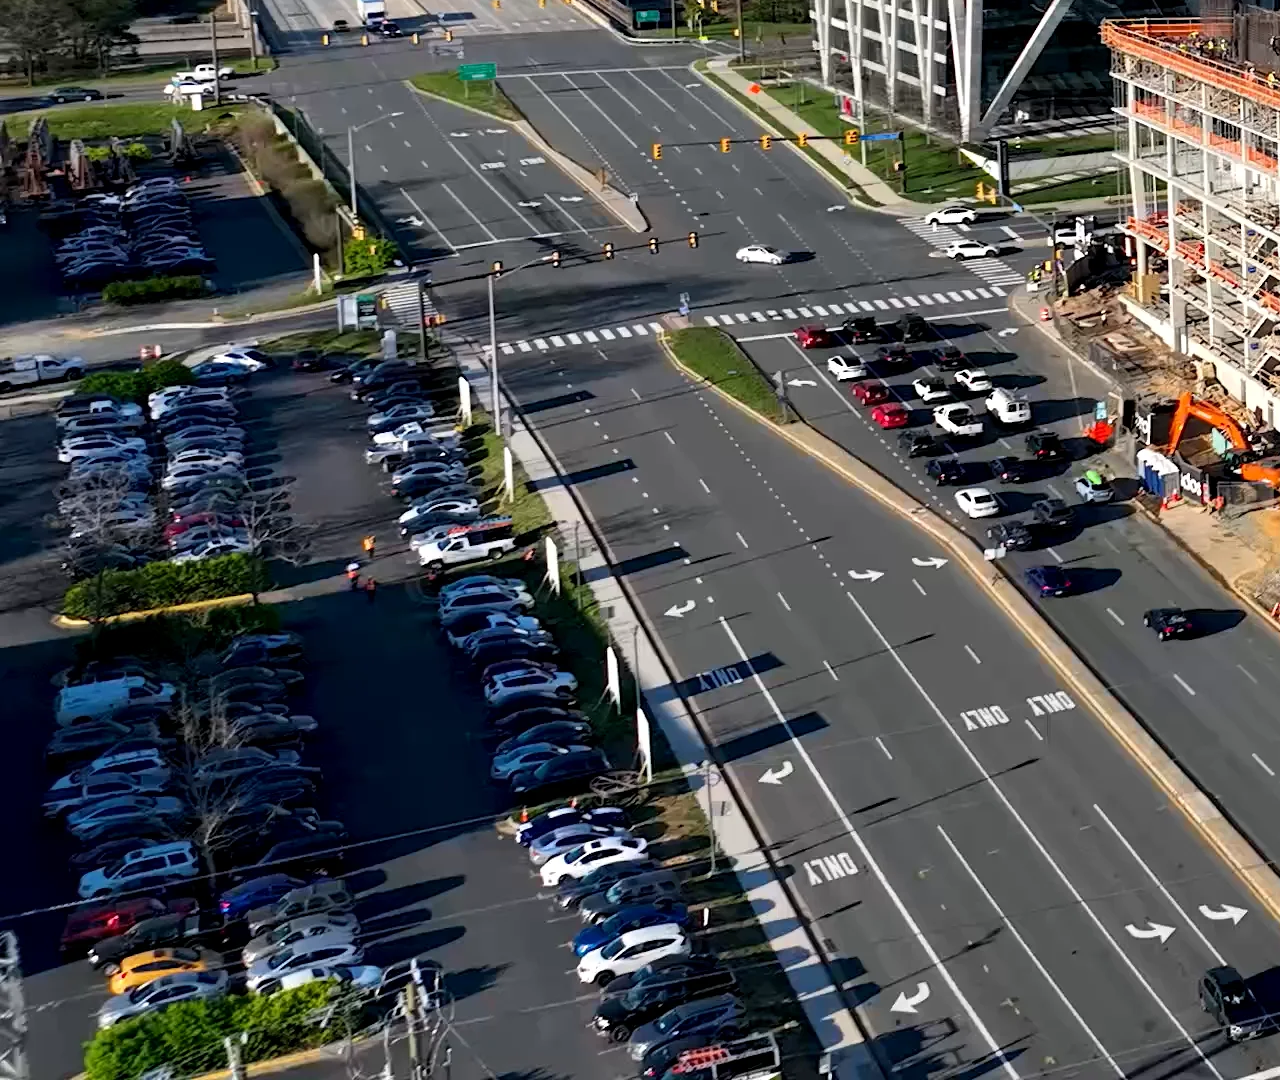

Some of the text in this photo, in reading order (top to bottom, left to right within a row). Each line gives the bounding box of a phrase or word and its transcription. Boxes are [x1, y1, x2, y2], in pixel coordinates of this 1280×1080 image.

[695, 667, 743, 692] ONLY
[960, 690, 1076, 731] ONLY ONLY
[803, 852, 859, 887] ONLY
